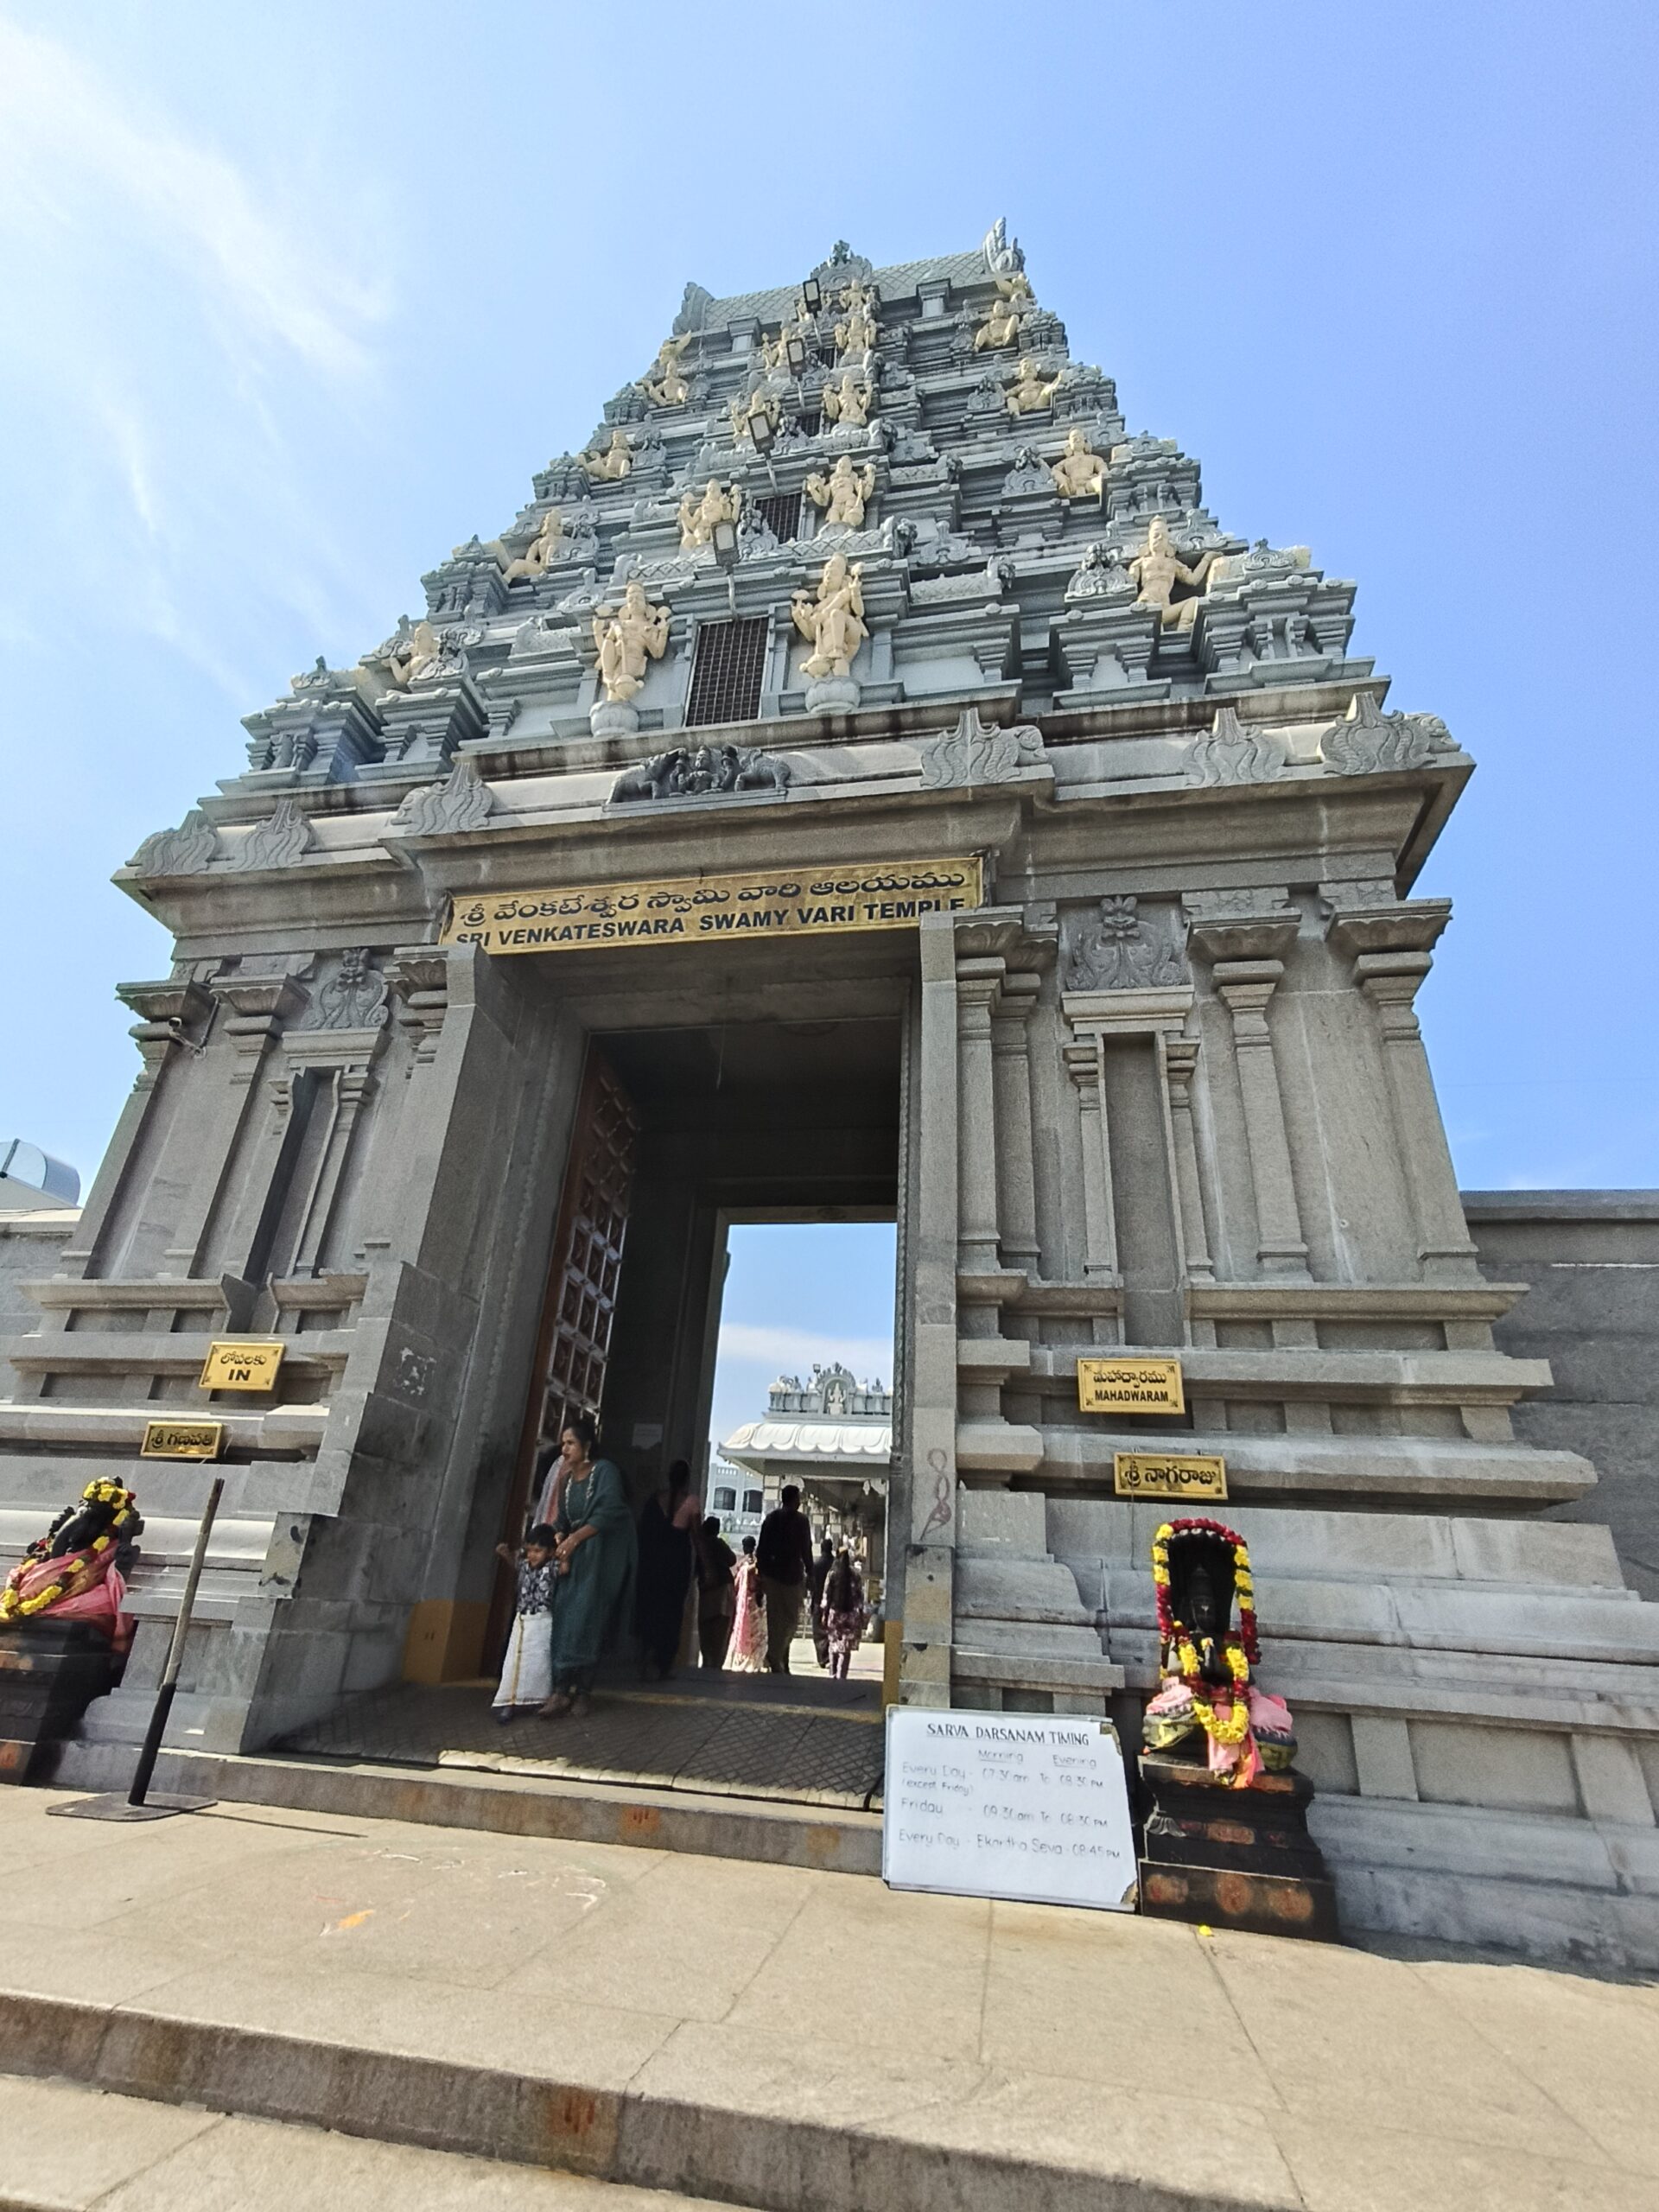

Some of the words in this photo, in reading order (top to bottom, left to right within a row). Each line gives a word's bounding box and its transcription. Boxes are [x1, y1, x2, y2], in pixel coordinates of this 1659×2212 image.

[460, 903, 486, 927] శ్రీ
[493, 893, 639, 918] వేంకటేశ్వర
[647, 889, 730, 912] స్వామి
[738, 882, 801, 901] వారి
[810, 872, 964, 895] ఆలయము
[499, 917, 684, 946] VENKATESWARA
[699, 910, 788, 931] SWAMY
[798, 905, 855, 925] VARI
[228, 1370, 251, 1381] IN
[1093, 1370, 1167, 1389] మహాద్వారము
[1094, 1389, 1169, 1402] MAHADWARAM
[151, 1429, 163, 1448] శ్రీ
[1125, 1460, 1141, 1487] శ్రీ
[1145, 1465, 1216, 1484] నాగరాజు
[926, 1723, 969, 1738] SARVA
[976, 1726, 1046, 1744] DARSANAM
[1049, 1731, 1090, 1746] TIMING
[902, 1762, 937, 1777] Every
[943, 1764, 965, 1780] Day
[1052, 1754, 1096, 1770] Evening
[901, 1796, 943, 1819] Friday
[899, 1828, 933, 1847] Every
[938, 1832, 960, 1849] Day
[1032, 1838, 1063, 1855] Seva
